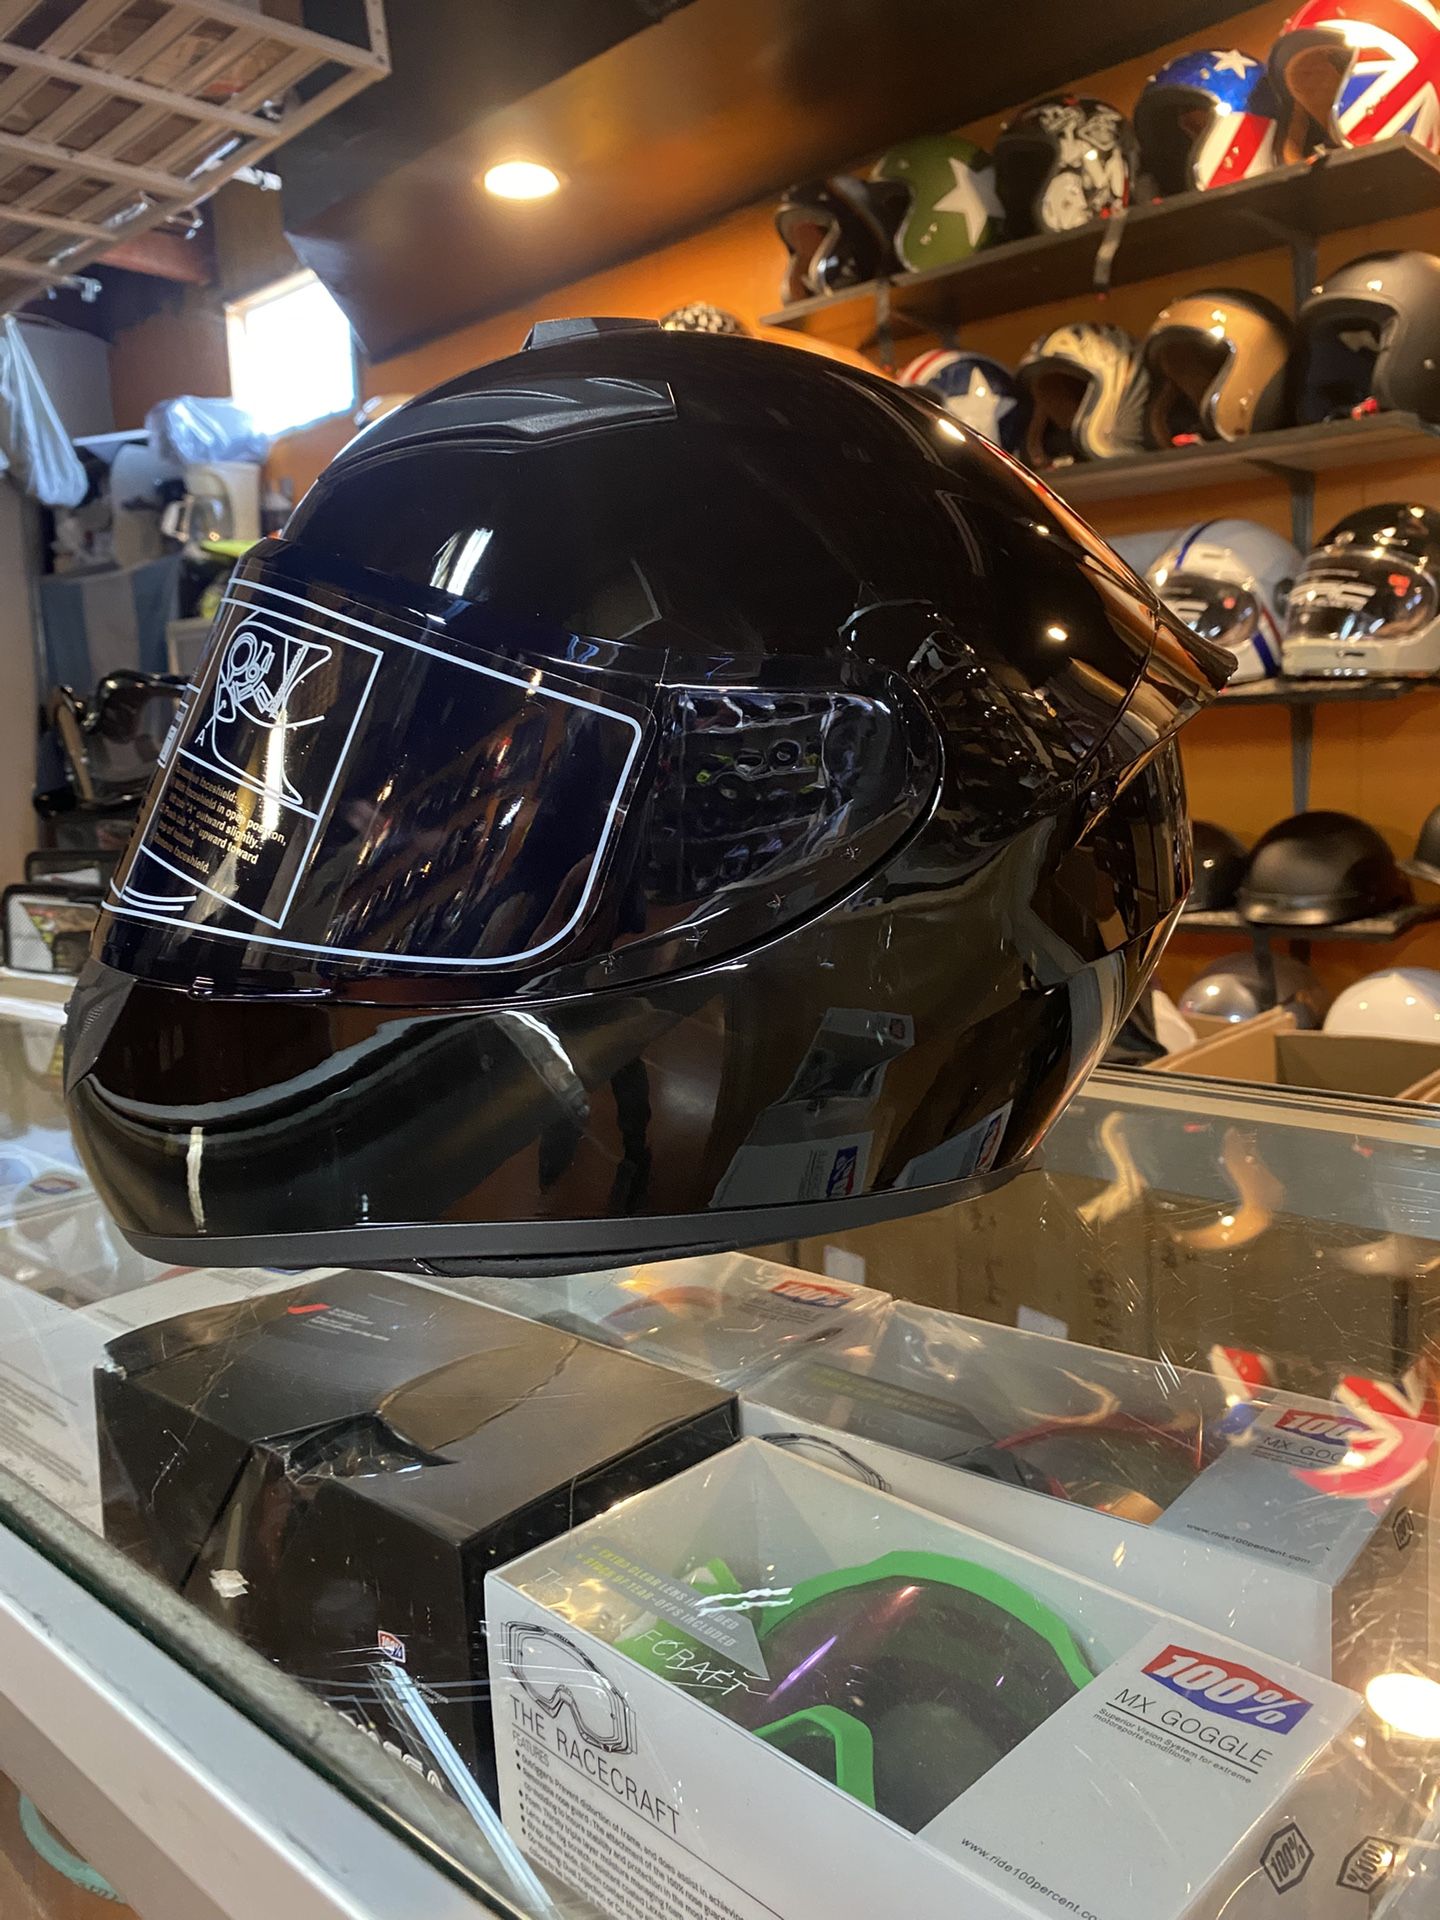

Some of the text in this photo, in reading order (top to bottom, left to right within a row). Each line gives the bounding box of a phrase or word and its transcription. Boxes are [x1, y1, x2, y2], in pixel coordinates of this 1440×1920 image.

[194, 728, 206, 747] A
[216, 804, 225, 813] in
[226, 808, 246, 824] open
[198, 829, 226, 849] upward
[227, 842, 259, 864] toward
[1263, 1436, 1293, 1450] MX
[658, 1583, 688, 1601] LENS
[680, 1613, 737, 1647] INCLUDED
[1151, 1654, 1301, 1725] 100%
[1093, 1713, 1144, 1742] motorsports
[1114, 1688, 1273, 1768] MX GOGGLE
[1098, 1707, 1252, 1784] Superior Vision System for extreme
[510, 1694, 680, 1834] THE RACECRAFT
[1270, 1831, 1306, 1883] 100%
[961, 1838, 1101, 1920] www.ride100percent.co
